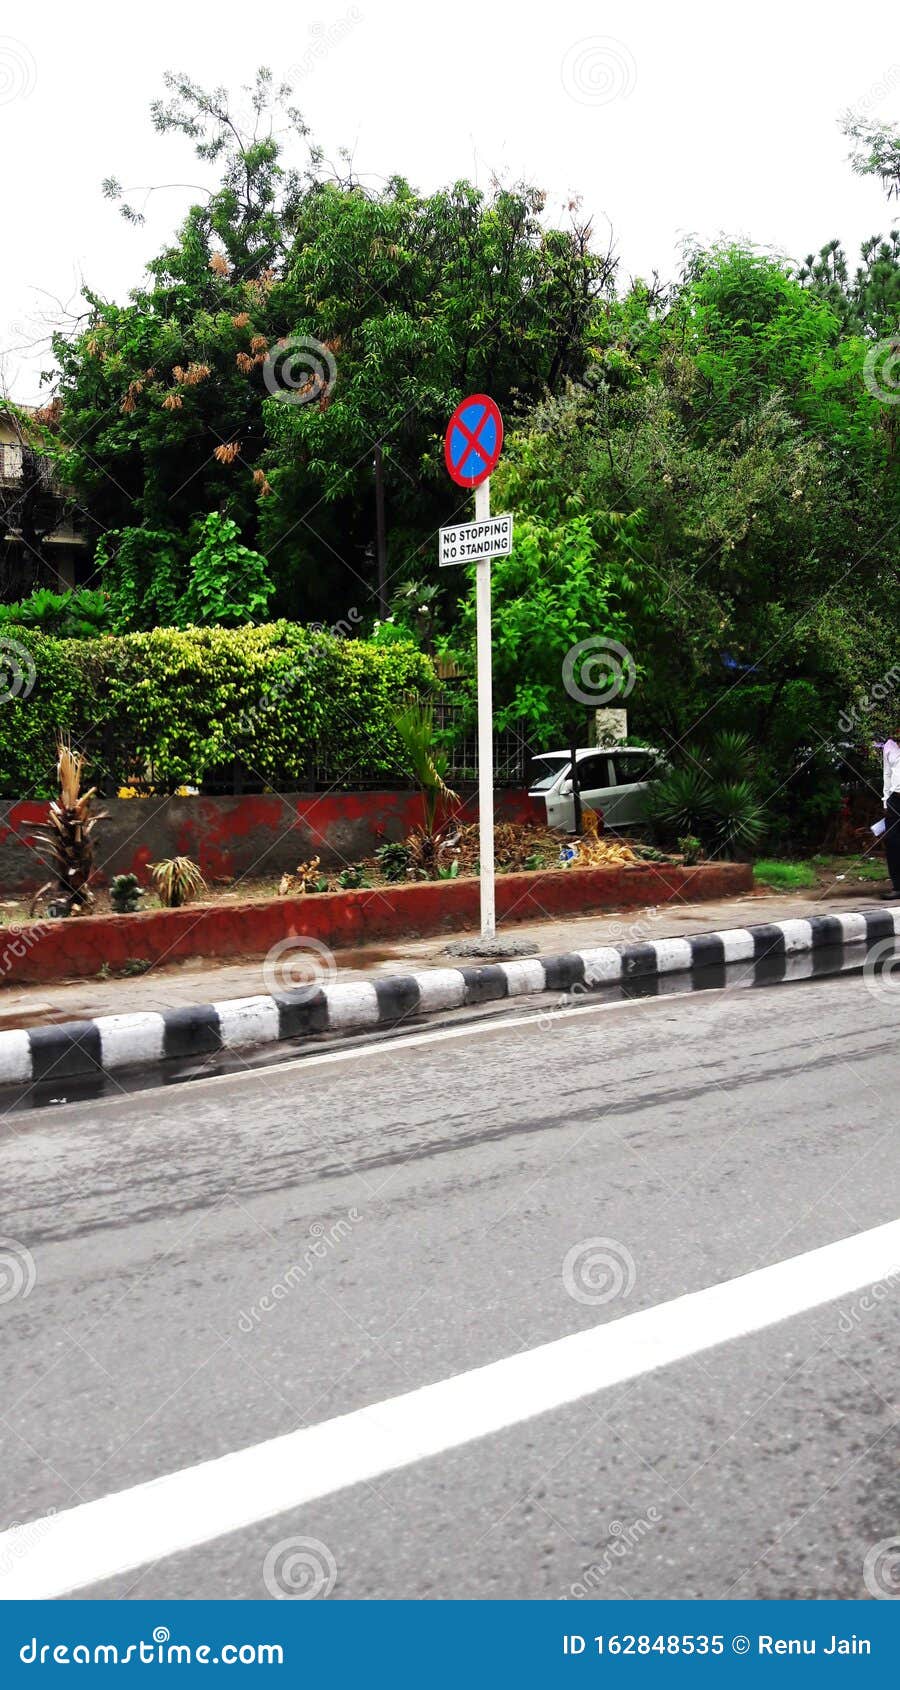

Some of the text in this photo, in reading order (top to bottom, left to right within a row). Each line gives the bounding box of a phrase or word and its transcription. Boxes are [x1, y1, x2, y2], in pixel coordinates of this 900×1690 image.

[443, 522, 508, 544] NO STOPPING
[443, 537, 508, 558] NO STANDING
